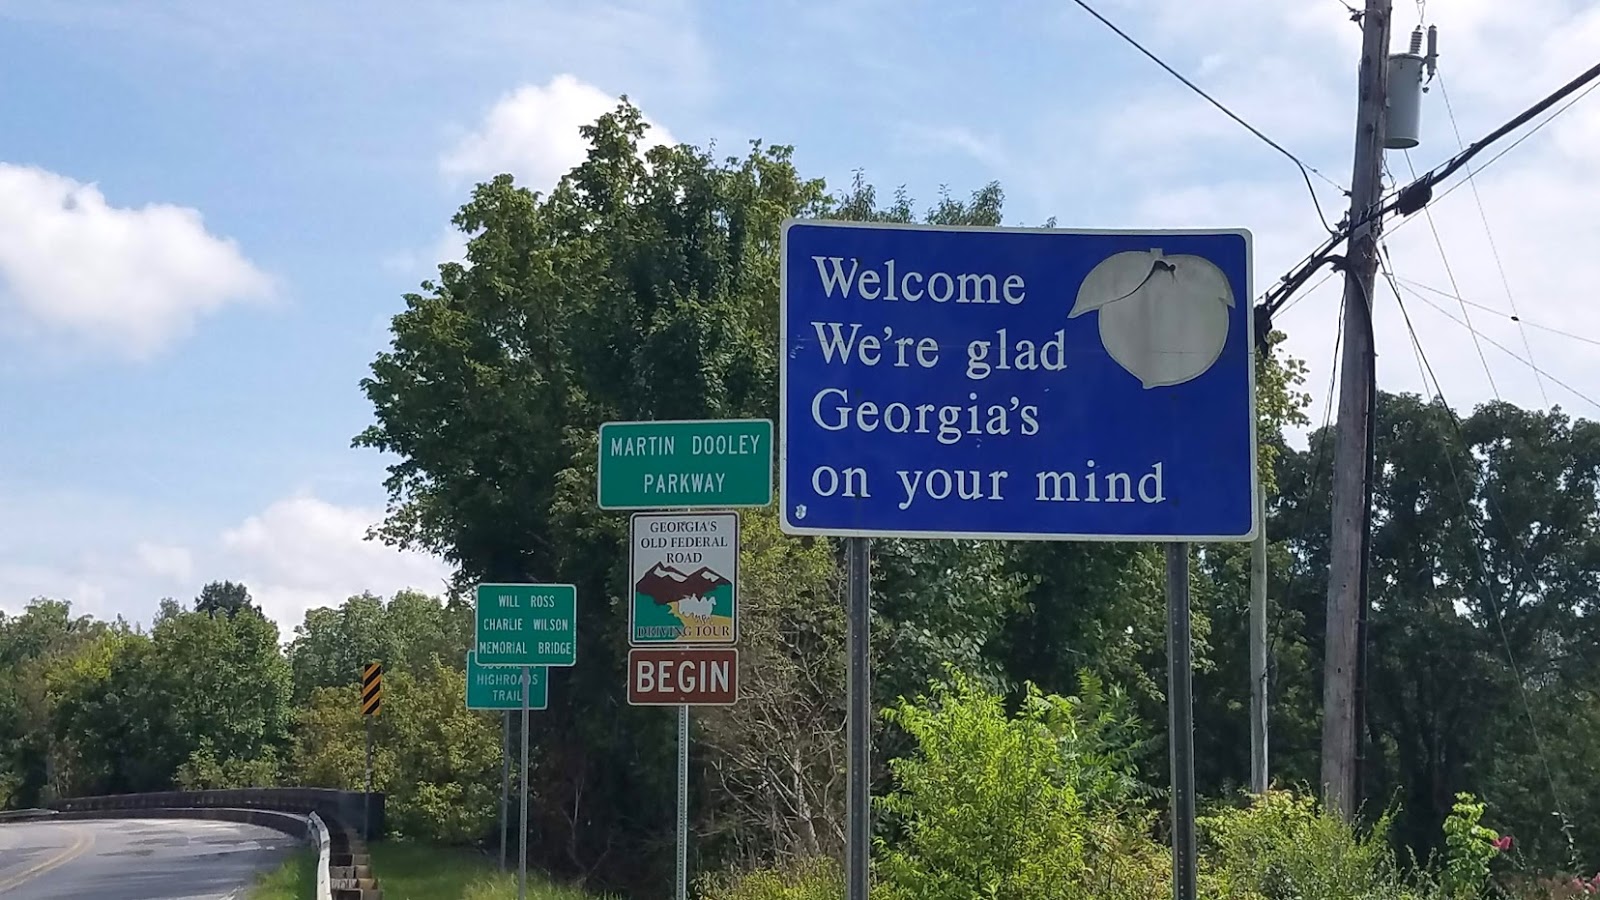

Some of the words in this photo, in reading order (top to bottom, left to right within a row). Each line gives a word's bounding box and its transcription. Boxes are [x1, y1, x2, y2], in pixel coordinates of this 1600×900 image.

[811, 255, 1026, 305] Welcome
[811, 321, 939, 368] We're
[966, 329, 1067, 380] glad
[811, 388, 1040, 445] Georgia's
[611, 436, 675, 456] MARTIN
[692, 434, 760, 455] DOOLEY
[644, 473, 725, 494] PARKWAY
[811, 464, 871, 499] on
[897, 468, 1008, 510] your
[1035, 460, 1167, 503] mind
[650, 521, 717, 533] GEORGIA'S
[641, 537, 667, 548] OLD
[670, 536, 728, 548] FEDERAL
[666, 552, 702, 563] ROAD
[498, 595, 520, 608] WILL
[530, 595, 555, 608] ROSS
[483, 618, 523, 631] CHARLIE
[533, 618, 568, 631] WILSON
[638, 626, 691, 637] DRIVING
[696, 626, 730, 637] TOUR
[479, 641, 527, 654] MEMORIAL
[538, 641, 572, 654] BRIDGE
[636, 660, 730, 693] BEGIN
[492, 690, 523, 701] TRAIL
